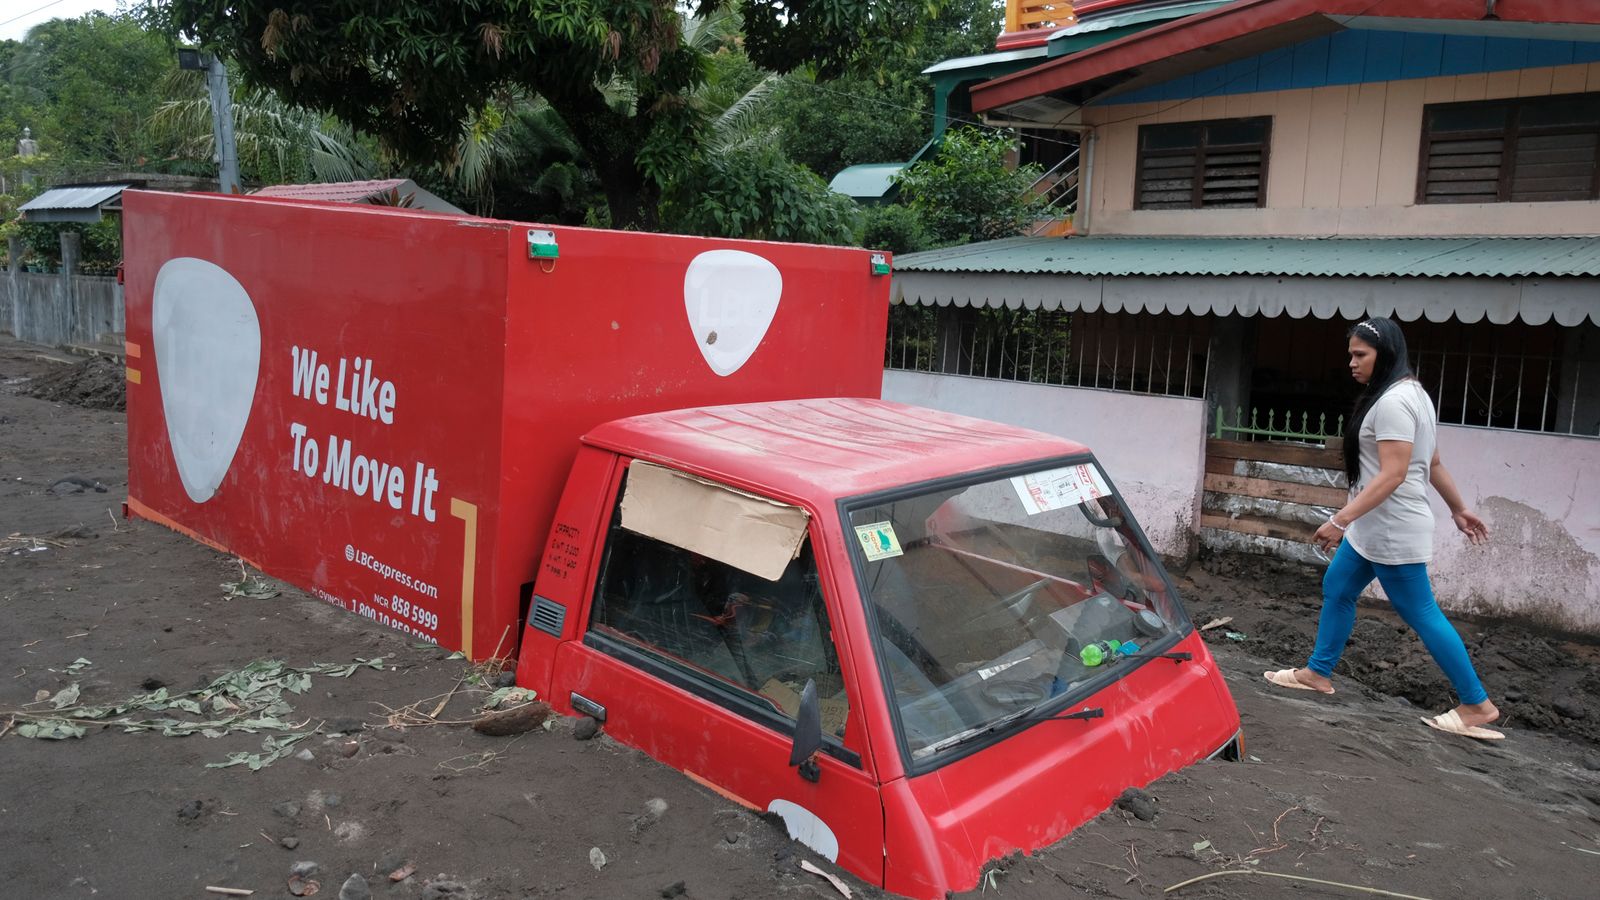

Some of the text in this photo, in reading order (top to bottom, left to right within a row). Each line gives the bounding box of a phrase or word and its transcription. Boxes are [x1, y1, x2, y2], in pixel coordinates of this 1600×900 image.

[291, 345, 330, 405] We
[335, 356, 396, 425] Like
[290, 422, 439, 523] To Move It
[355, 549, 438, 599] LBCexpress.com
[351, 599, 357, 613] 1
[373, 593, 438, 631] NCR 858 5999
